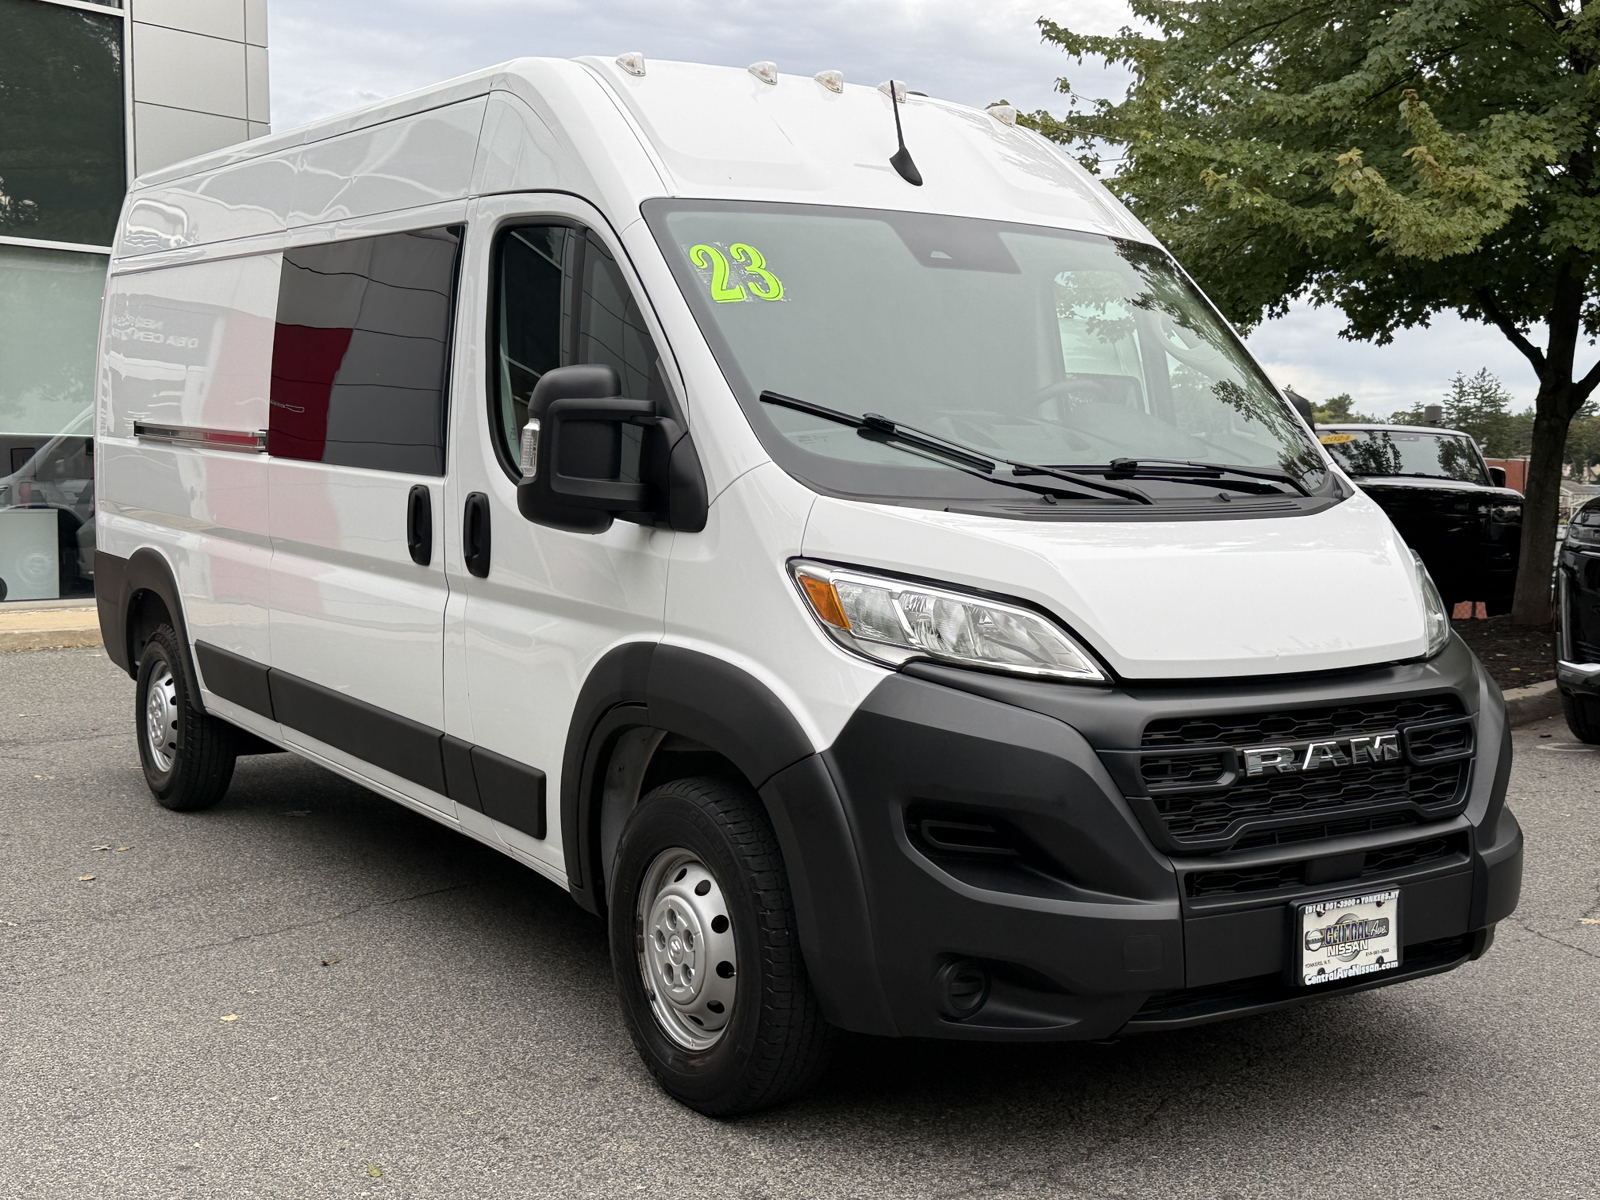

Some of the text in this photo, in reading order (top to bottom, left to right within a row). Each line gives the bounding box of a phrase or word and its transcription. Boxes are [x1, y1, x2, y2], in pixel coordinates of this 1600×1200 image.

[689, 243, 784, 304] 23
[1243, 734, 1399, 777] RAM
[1325, 919, 1371, 945] CENTRAL
[1327, 940, 1369, 957] NISSAN
[1304, 961, 1399, 985] CentralAveNissan.com
